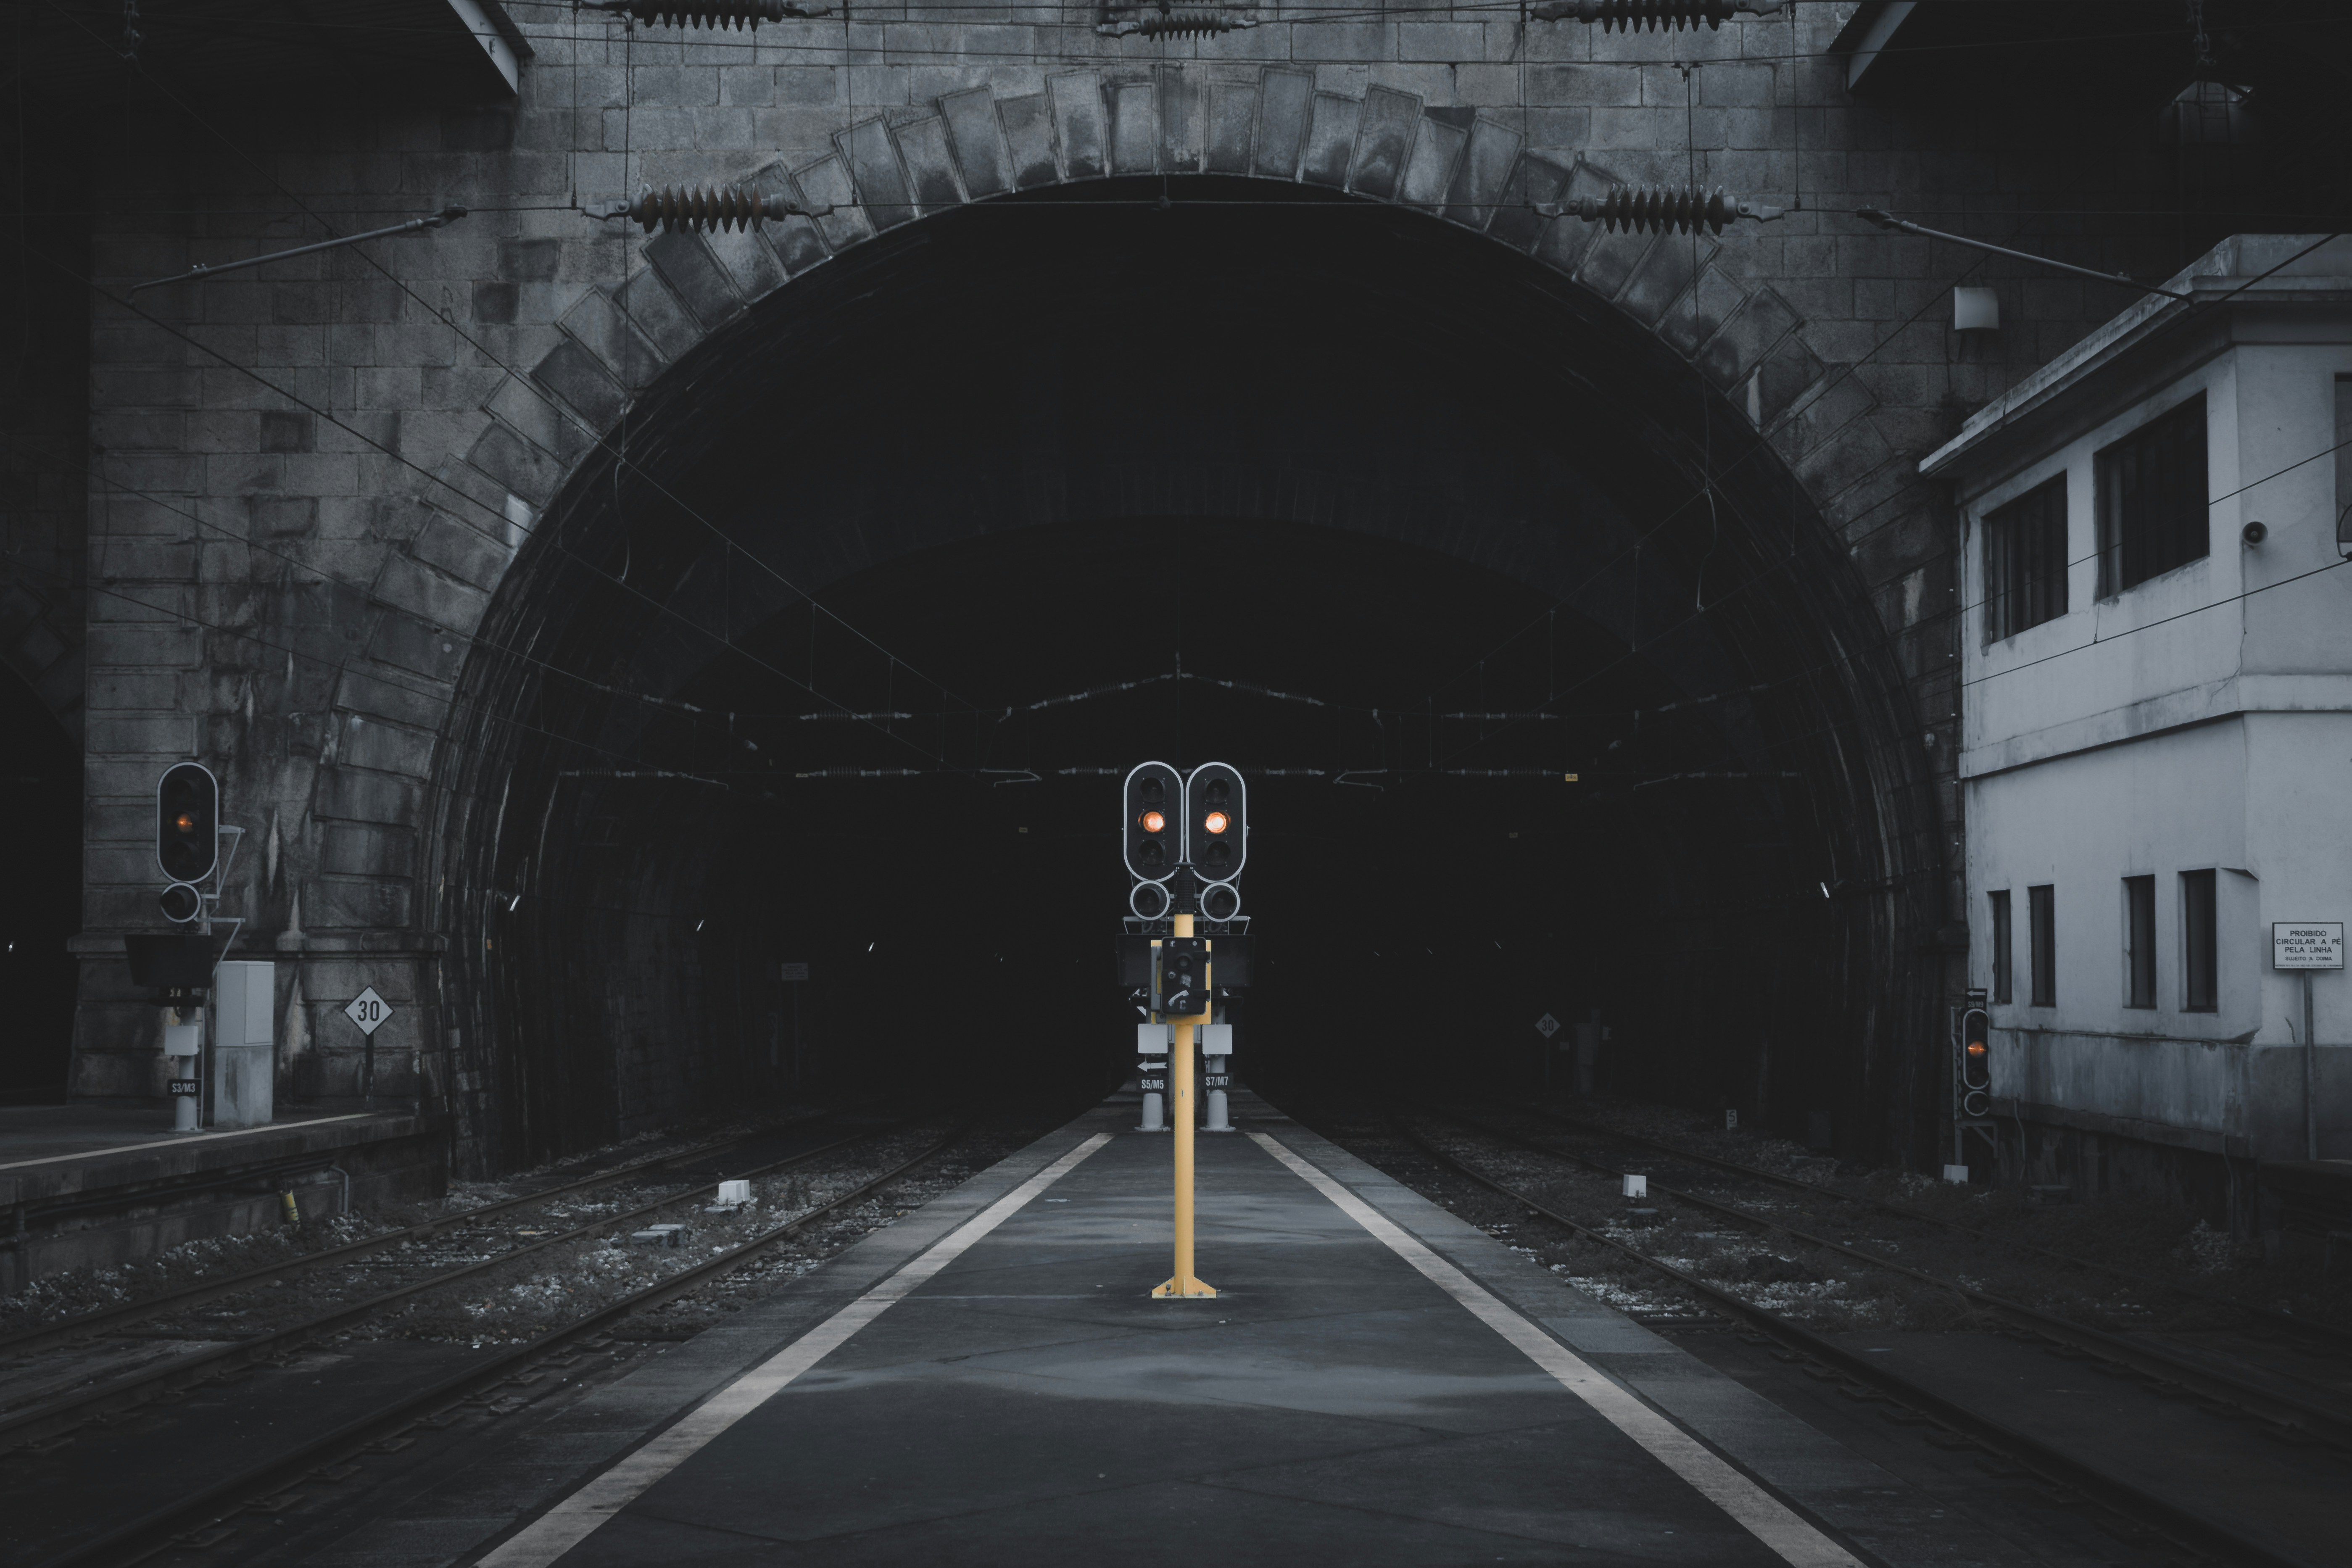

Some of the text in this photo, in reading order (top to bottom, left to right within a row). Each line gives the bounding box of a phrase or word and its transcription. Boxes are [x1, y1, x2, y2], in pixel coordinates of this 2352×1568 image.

[358, 1000, 380, 1022] 30
[1542, 1020, 1554, 1031] 30
[1142, 1079, 1164, 1089] S5/M5
[1206, 1076, 1229, 1086] S7/M7
[172, 1083, 195, 1093] S3/M3
